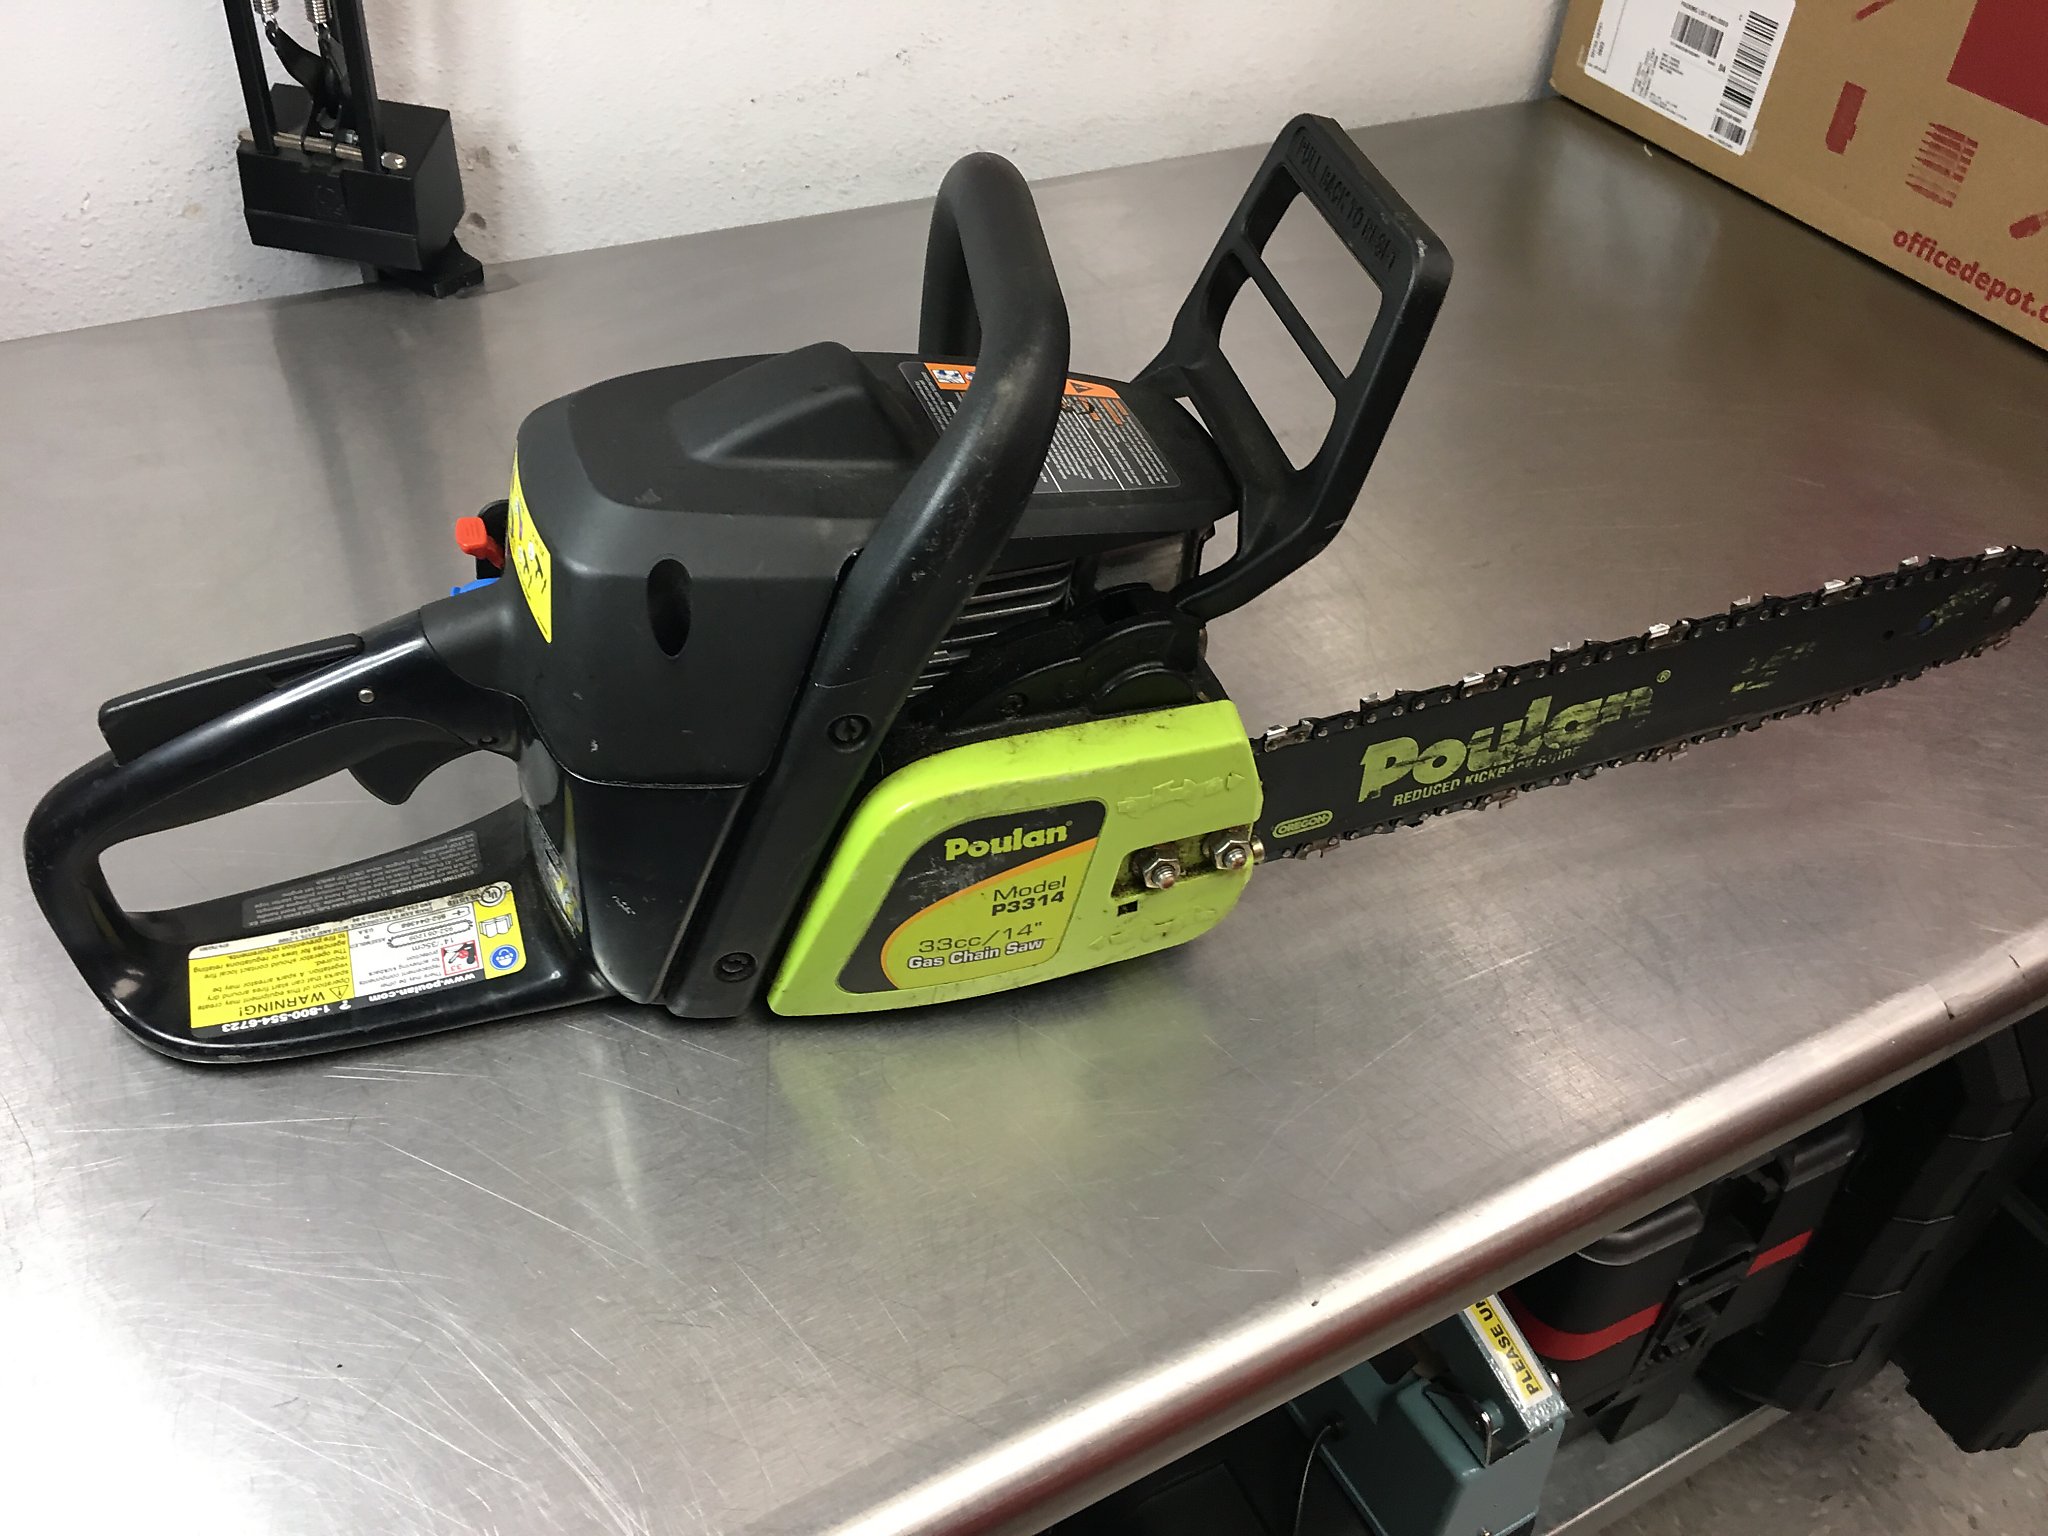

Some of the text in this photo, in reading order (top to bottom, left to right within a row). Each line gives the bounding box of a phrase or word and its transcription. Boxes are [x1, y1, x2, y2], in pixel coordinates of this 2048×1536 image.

[1358, 686, 1653, 802] Poulan
[1393, 778, 1461, 807] REDUCED
[1277, 814, 1327, 834] OREGON
[945, 825, 1068, 861] Poulan
[991, 890, 1065, 916] P3314
[994, 876, 1067, 902] Model
[918, 921, 1042, 953] 33cc/14"
[907, 938, 1045, 969] Gas Chain Saw
[367, 972, 476, 1003] www.poulan.com
[220, 1003, 331, 1032] 1-800-554-6723
[237, 989, 325, 1018] WARNING!
[1490, 1324, 1539, 1395] PLEASE
